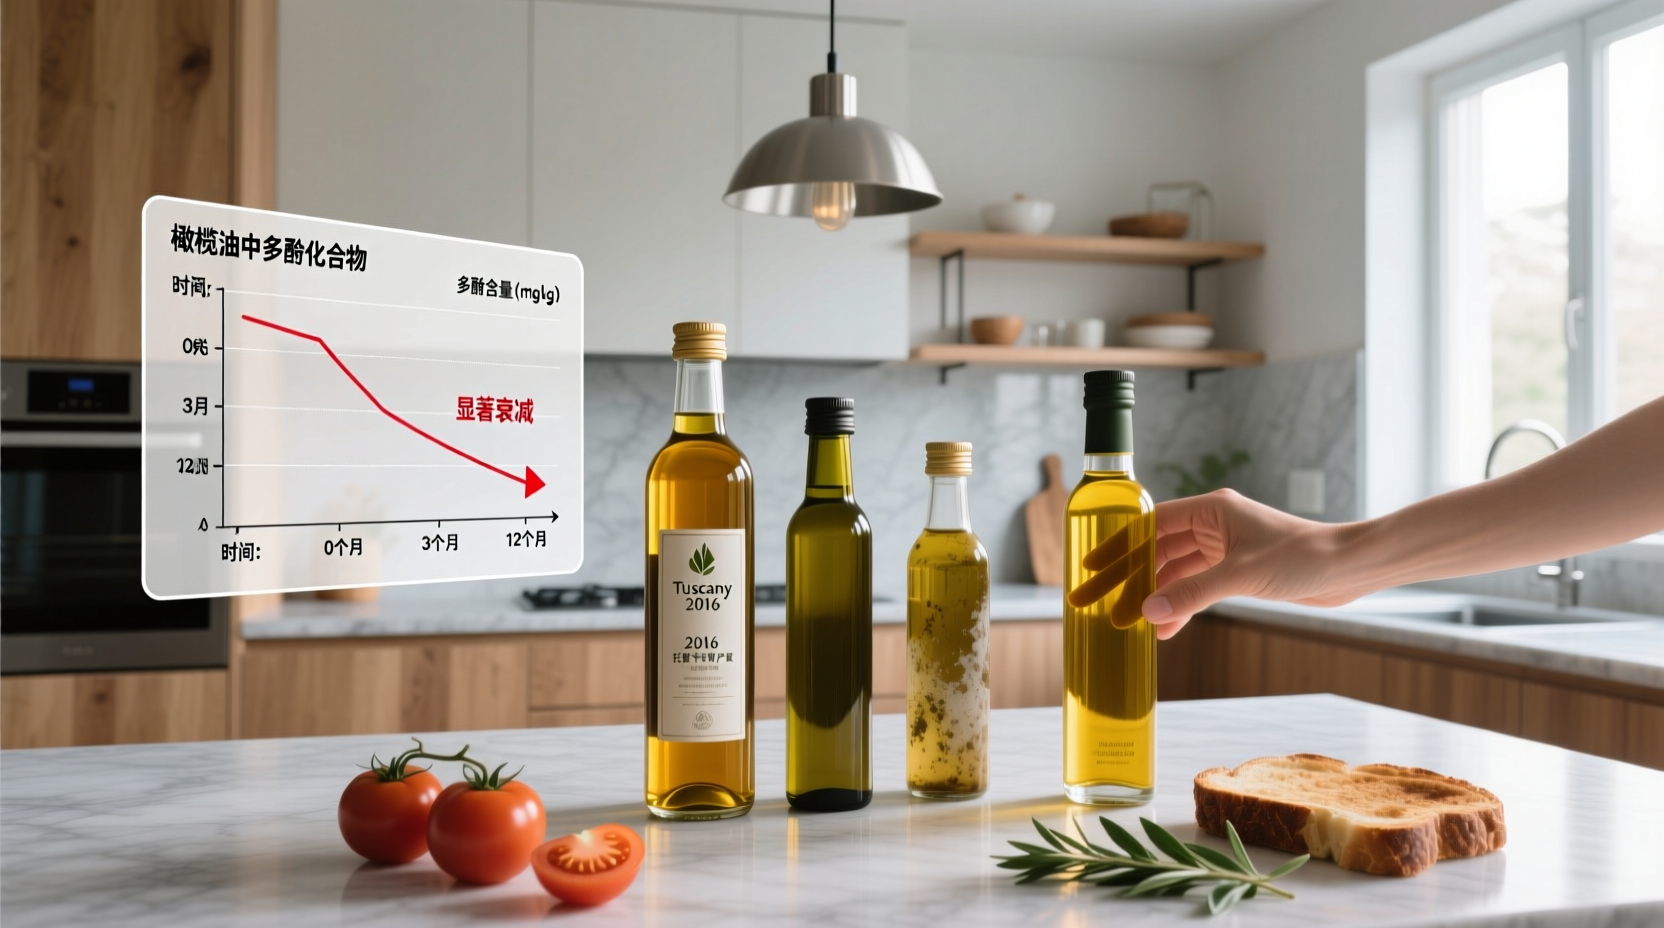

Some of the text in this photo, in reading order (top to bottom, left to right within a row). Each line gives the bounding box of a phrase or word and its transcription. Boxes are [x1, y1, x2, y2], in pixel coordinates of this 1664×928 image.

[672, 580, 733, 600] Tuscany
[685, 597, 721, 611] 2016
[684, 636, 719, 650] 2016
